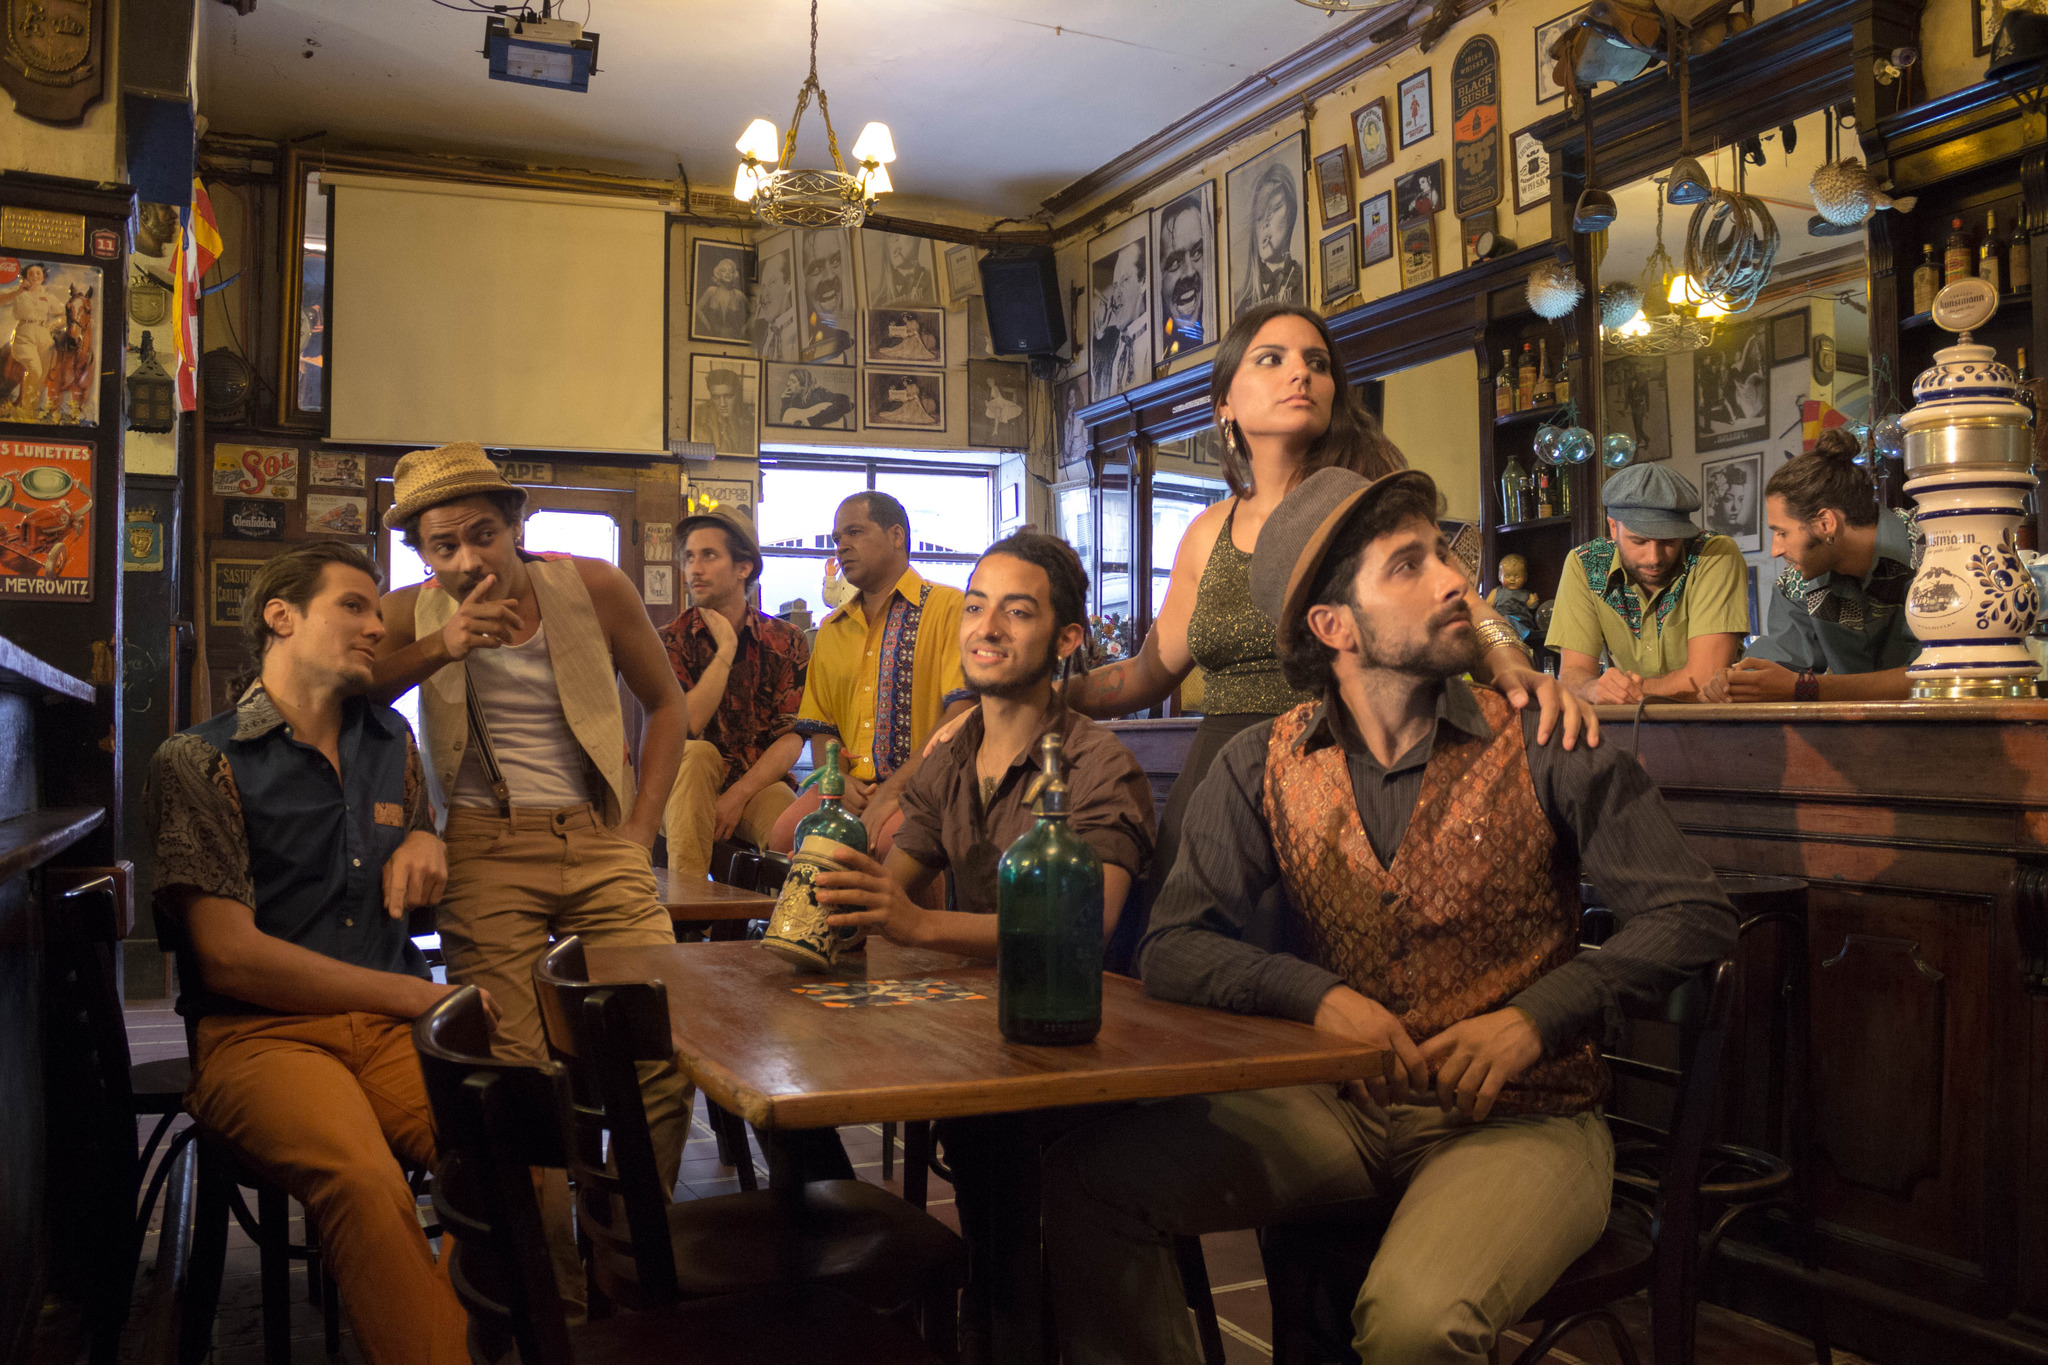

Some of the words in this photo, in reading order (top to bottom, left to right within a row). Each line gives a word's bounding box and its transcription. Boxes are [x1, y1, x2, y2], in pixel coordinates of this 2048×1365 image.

[1458, 73, 1492, 98] BLACK
[1461, 86, 1489, 107] BUSH
[97, 239, 114, 251] 11
[14, 444, 90, 461] LUNETTES
[232, 514, 276, 529] Glenfiddich
[5, 577, 88, 595] MEYROWITZ
